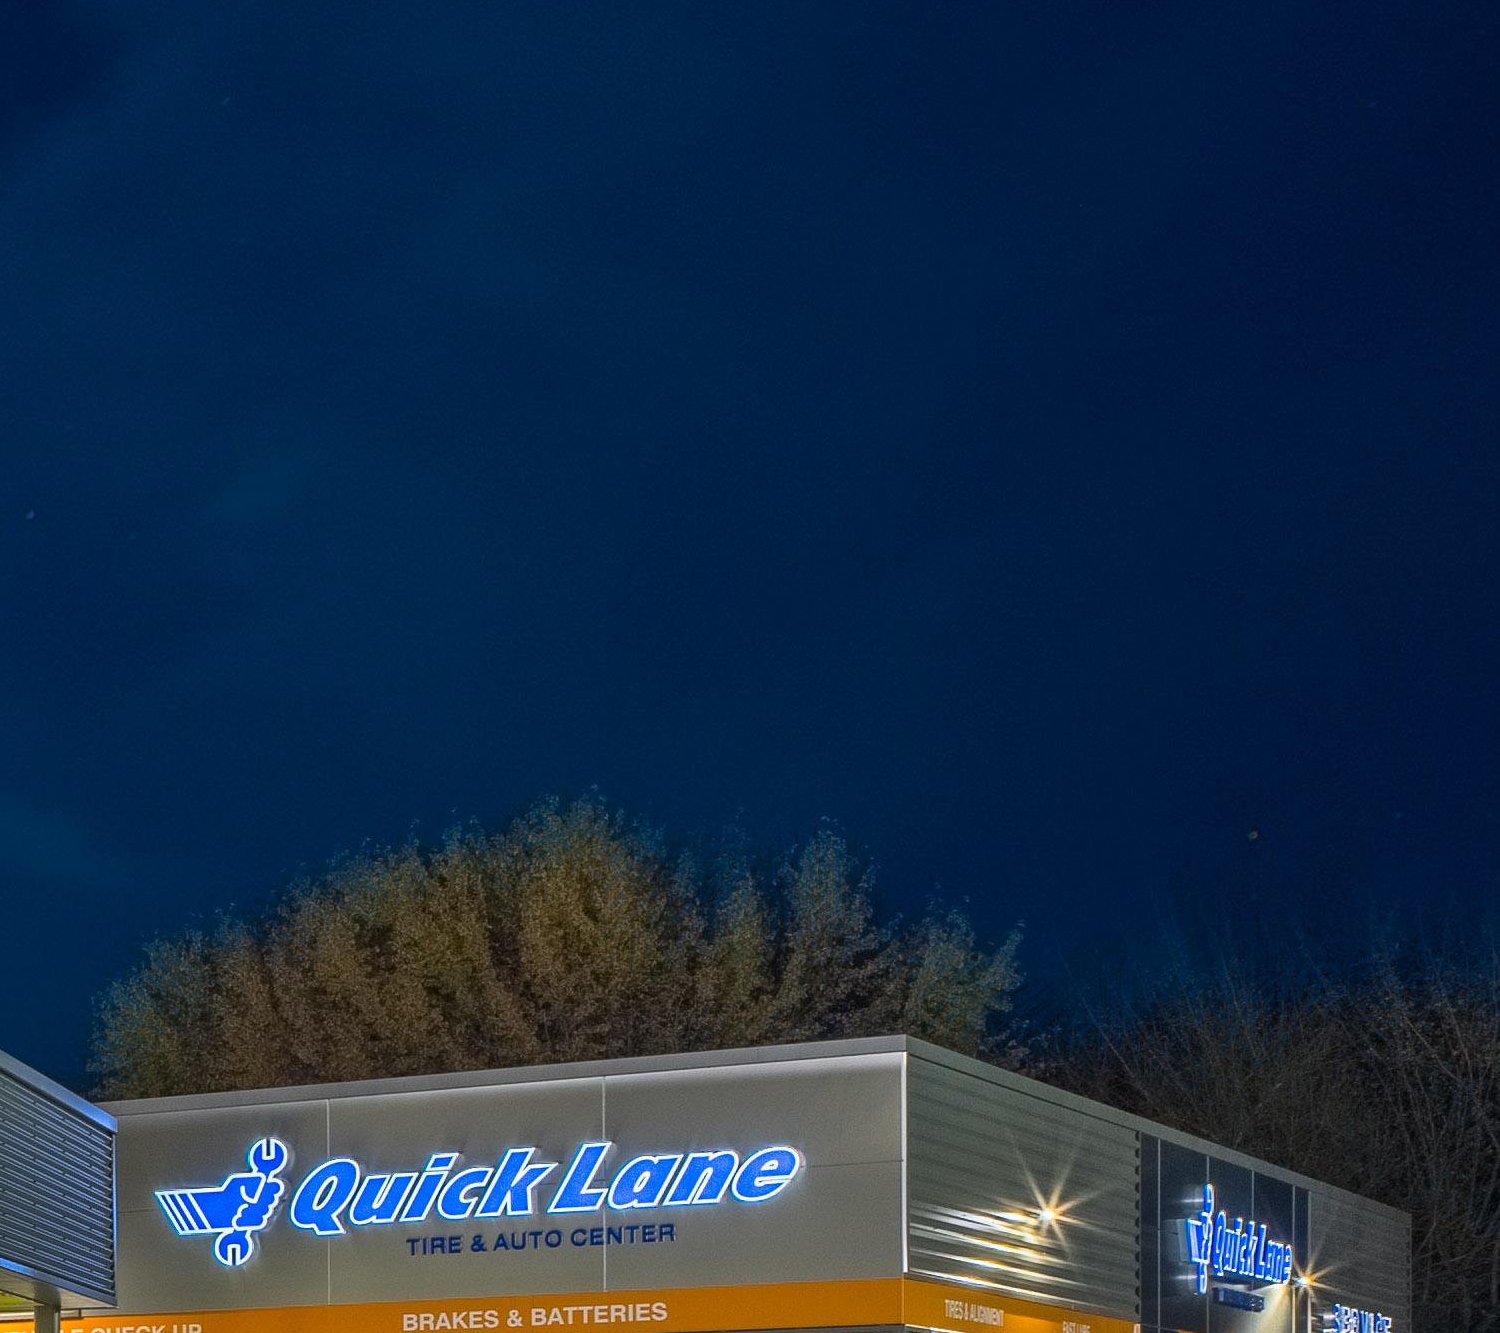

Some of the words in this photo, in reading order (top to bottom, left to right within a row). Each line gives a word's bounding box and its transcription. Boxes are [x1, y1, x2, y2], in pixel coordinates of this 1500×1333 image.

[289, 1145, 559, 1236] Quick
[547, 1140, 801, 1215] Lane
[406, 1235, 462, 1257] TIRE
[472, 1234, 488, 1254] &
[492, 1229, 563, 1253] AUTO
[569, 1223, 677, 1249] CENTER
[1212, 1210, 1259, 1277] Quick
[402, 1308, 500, 1332] BRAKES
[506, 1308, 523, 1328] &
[530, 1301, 668, 1327] BATTERIES
[944, 1299, 964, 1320] TIRES
[969, 1304, 1004, 1327] ALIGNMENT
